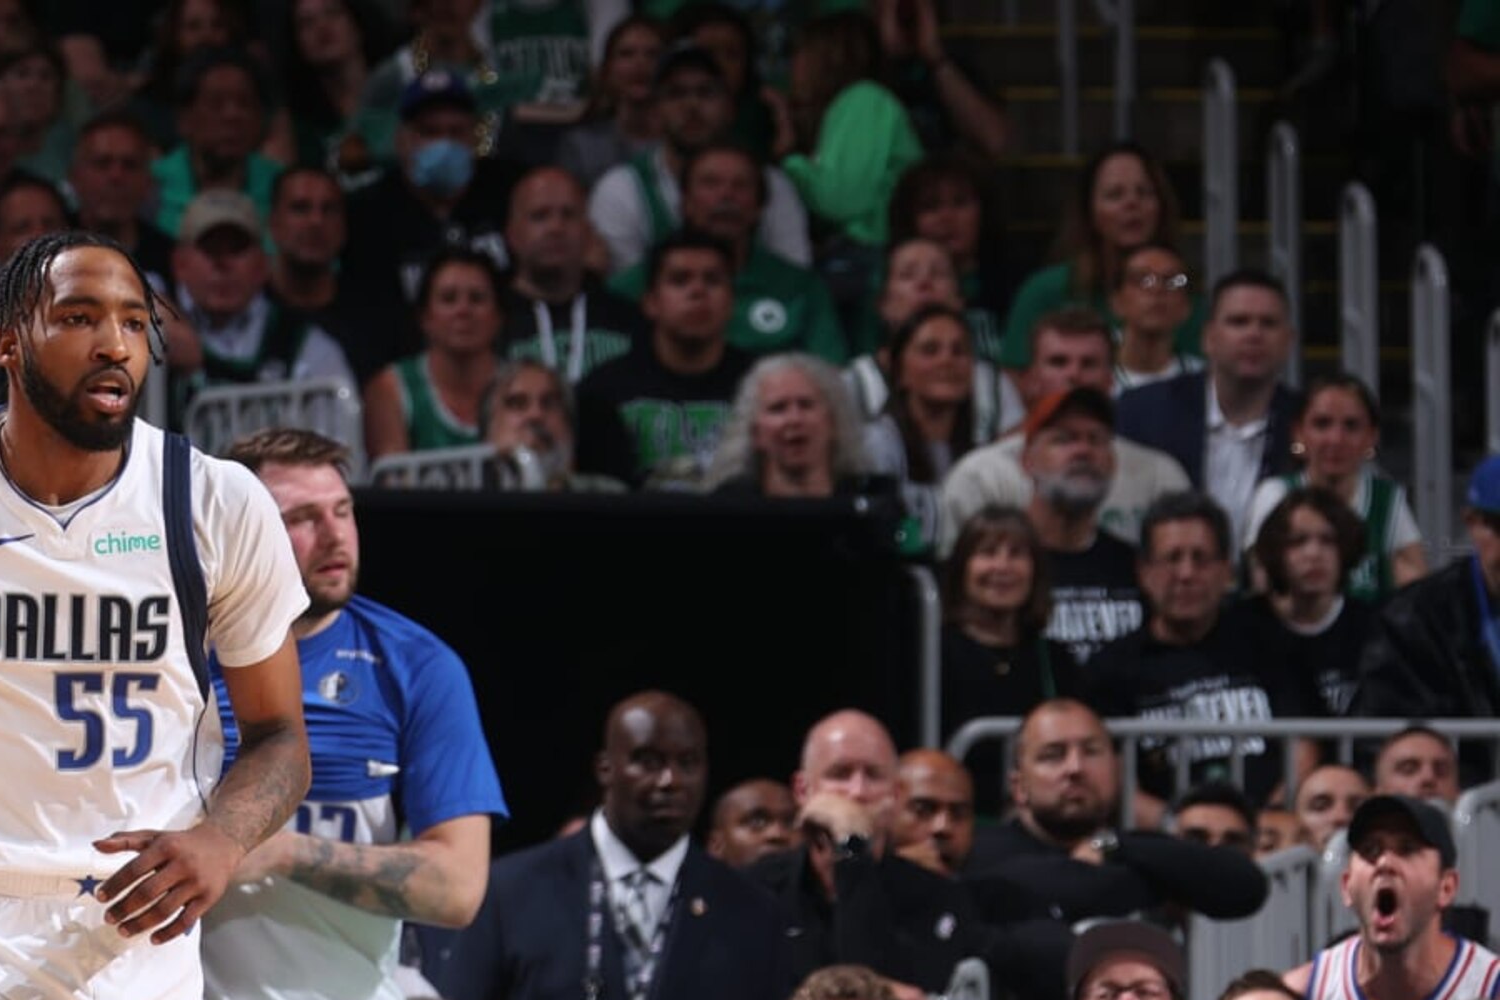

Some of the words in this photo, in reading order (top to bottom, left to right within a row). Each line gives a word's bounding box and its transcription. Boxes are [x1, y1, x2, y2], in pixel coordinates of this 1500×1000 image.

[94, 532, 161, 555] chime
[54, 671, 161, 770] 55
[297, 804, 357, 843] 7
